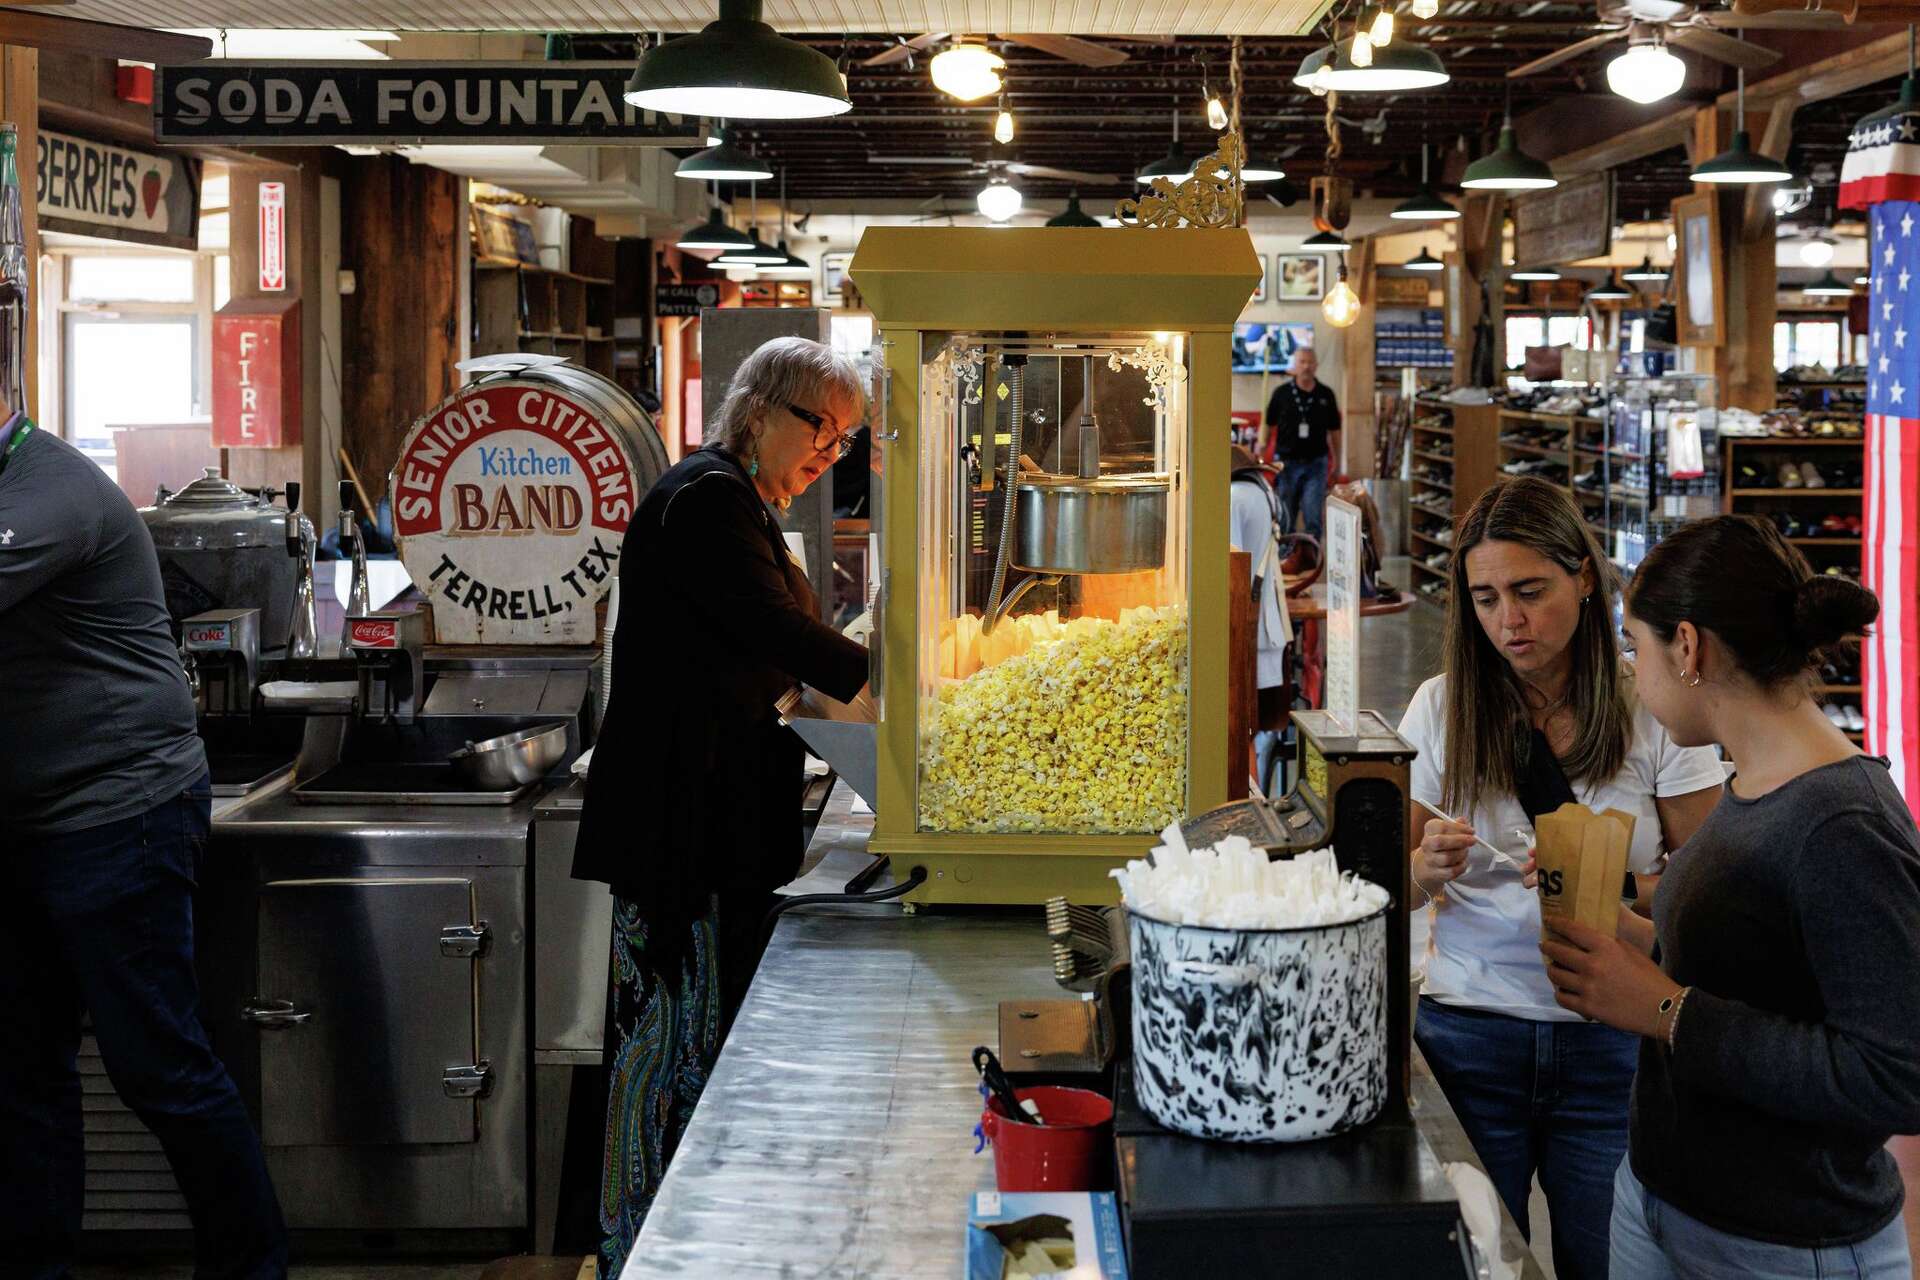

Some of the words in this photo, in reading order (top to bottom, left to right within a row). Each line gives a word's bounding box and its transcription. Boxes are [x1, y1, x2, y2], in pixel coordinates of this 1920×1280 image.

[175, 78, 352, 126] SODA
[239, 331, 257, 438] FIRE
[399, 397, 496, 521] SENIOR
[517, 391, 630, 522] CITIZENS
[477, 446, 571, 477] Kitchen
[450, 483, 583, 537] BAND
[428, 554, 572, 620] TERRELL,
[189, 629, 224, 641] Coke
